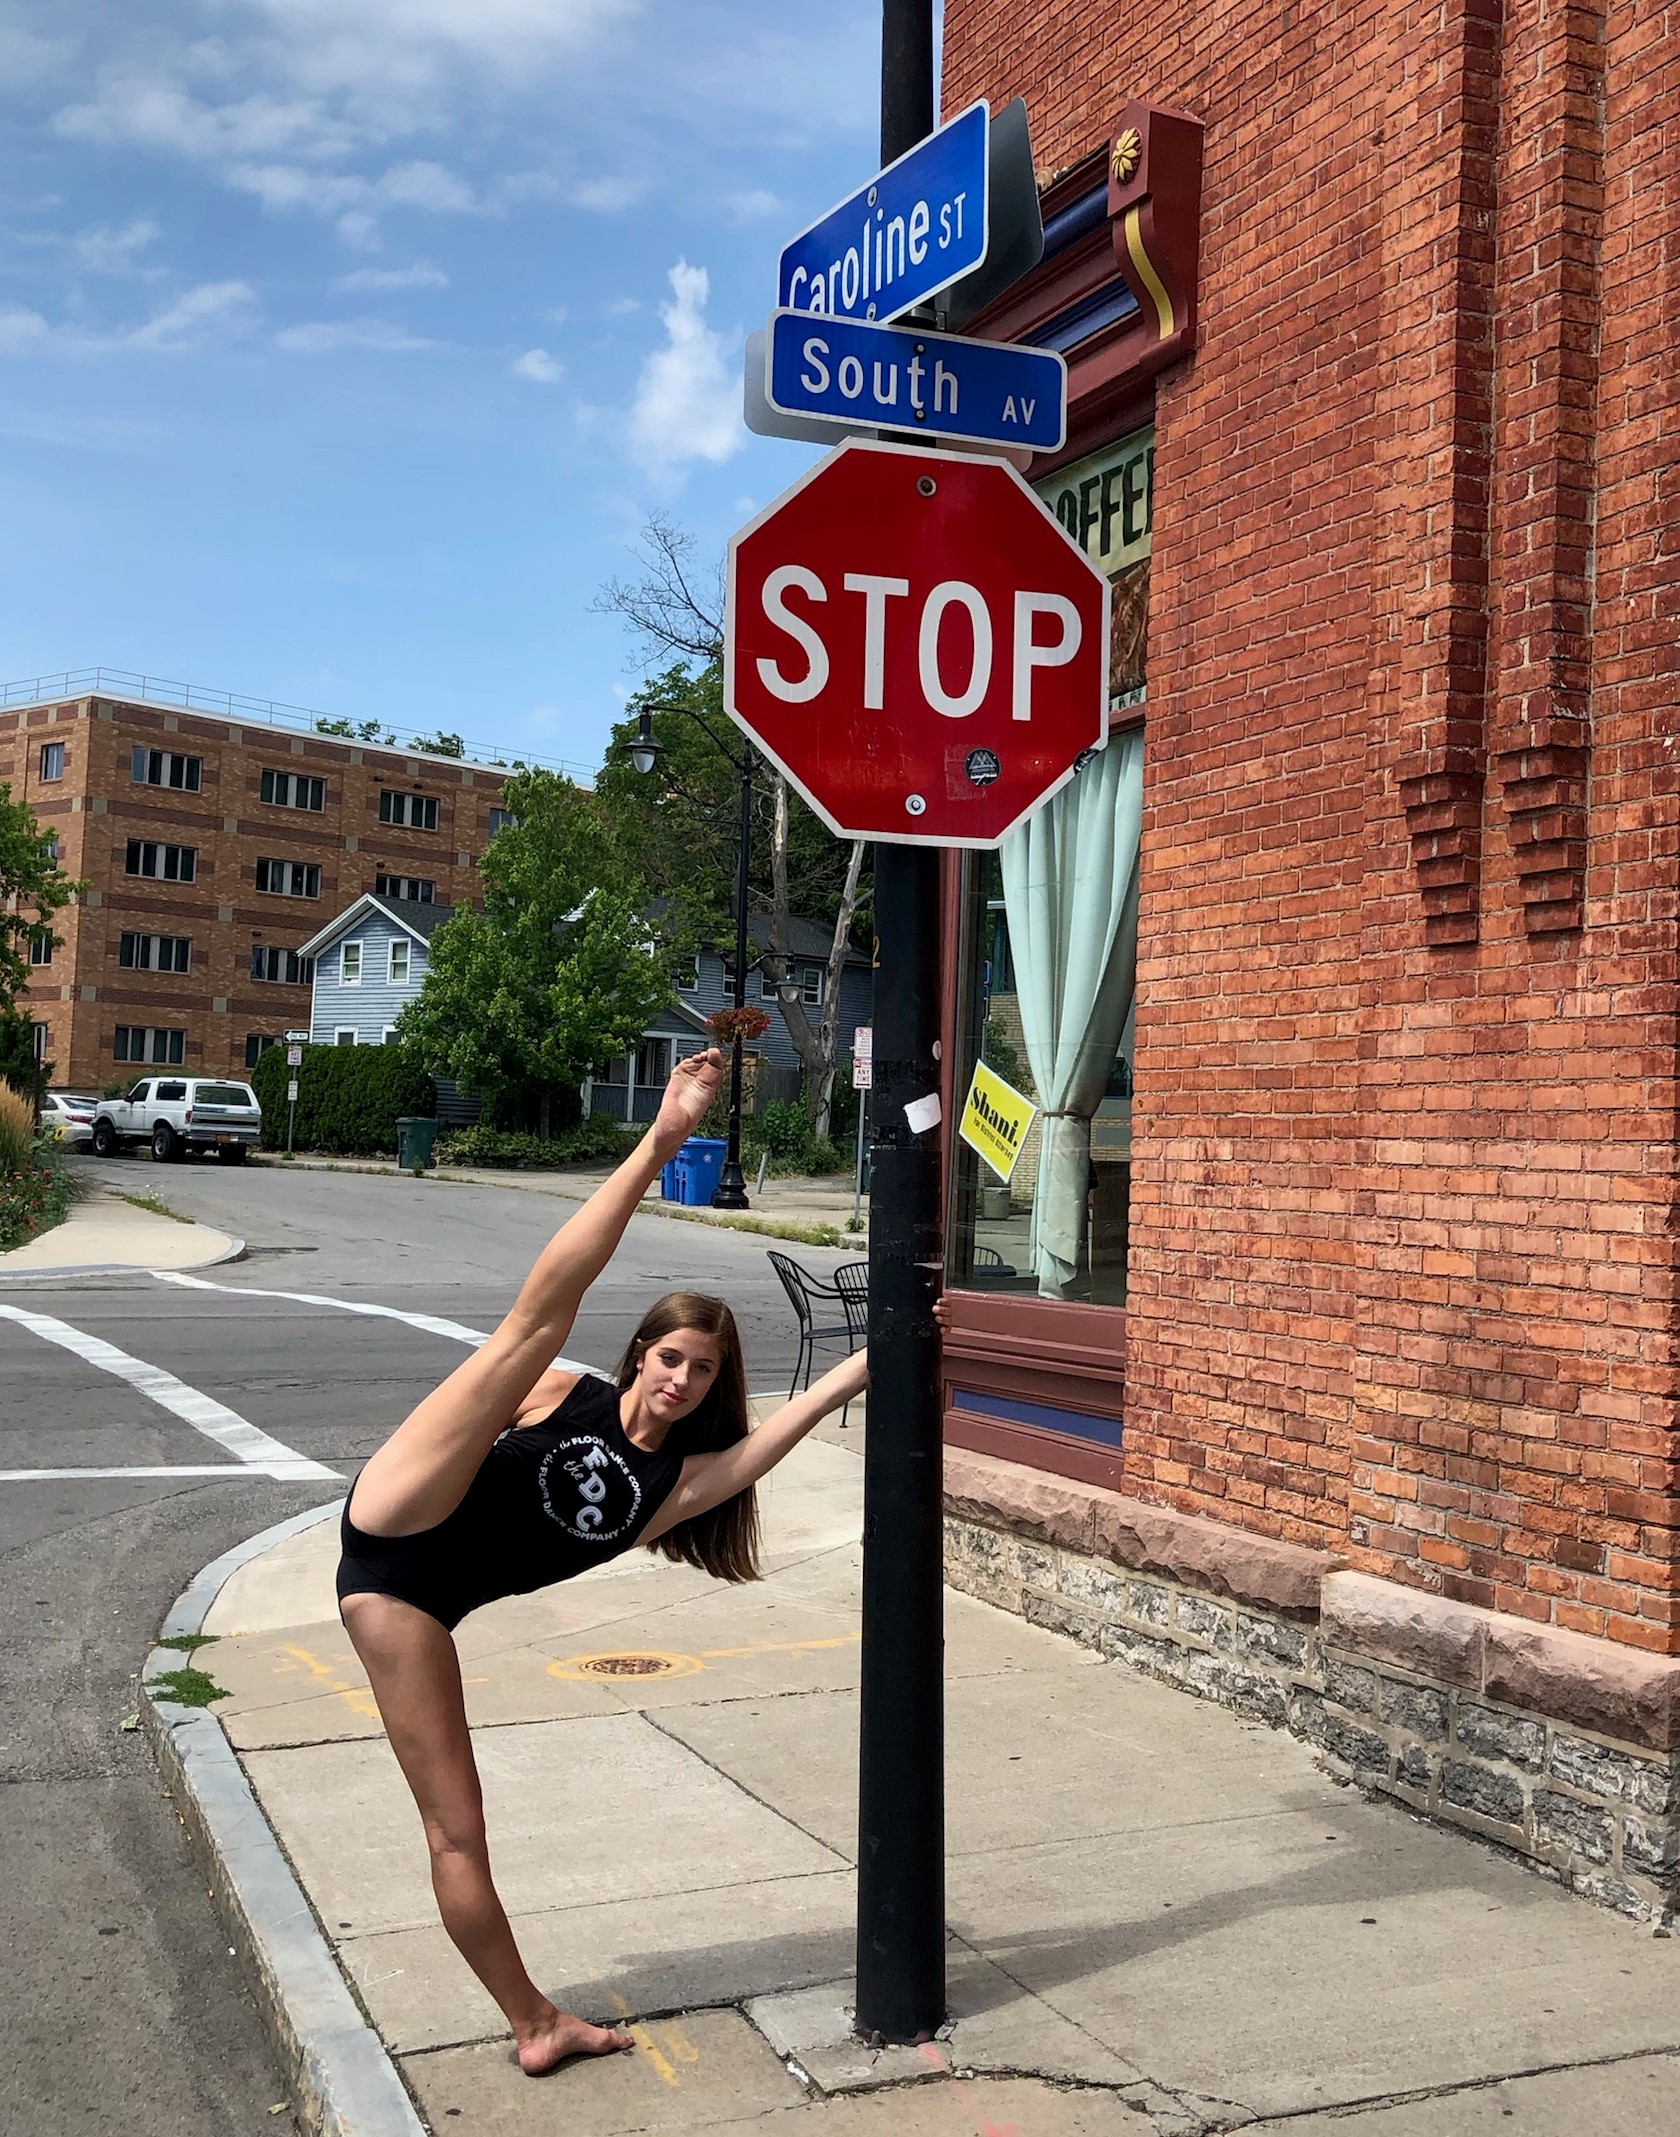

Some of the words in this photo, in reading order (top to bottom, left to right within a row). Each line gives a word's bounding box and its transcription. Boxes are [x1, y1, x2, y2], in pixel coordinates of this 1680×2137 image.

[789, 200, 930, 316] Caroline
[938, 191, 967, 249] ST
[800, 337, 959, 415] South
[1001, 395, 1036, 425] AV
[1044, 446, 1154, 557] OFFE
[755, 564, 1083, 722] STOP
[971, 1086, 1019, 1148] Shani.
[563, 1460, 585, 1481] the
[571, 1435, 604, 1447] FLOOR
[626, 1475, 642, 1527] COMPANY
[566, 1526, 619, 1541] COMPANY
